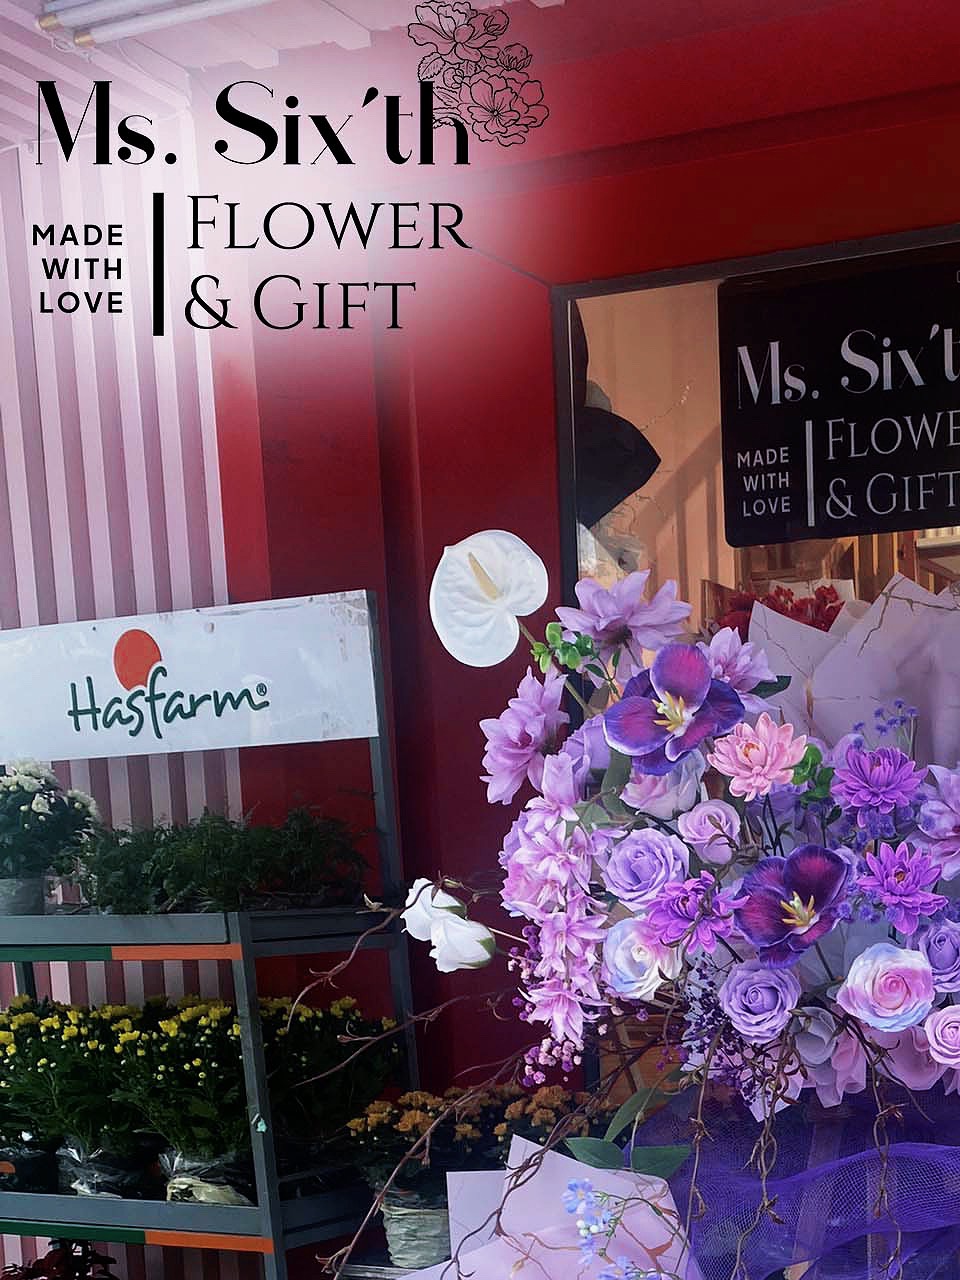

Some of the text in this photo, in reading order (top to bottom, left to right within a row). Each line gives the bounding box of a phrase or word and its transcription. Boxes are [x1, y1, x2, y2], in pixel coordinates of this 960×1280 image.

[737, 340, 820, 409] Ms.
[737, 447, 790, 469] MADE
[743, 471, 790, 492] WITH
[743, 496, 791, 517] LOVE
[825, 478, 857, 520] &
